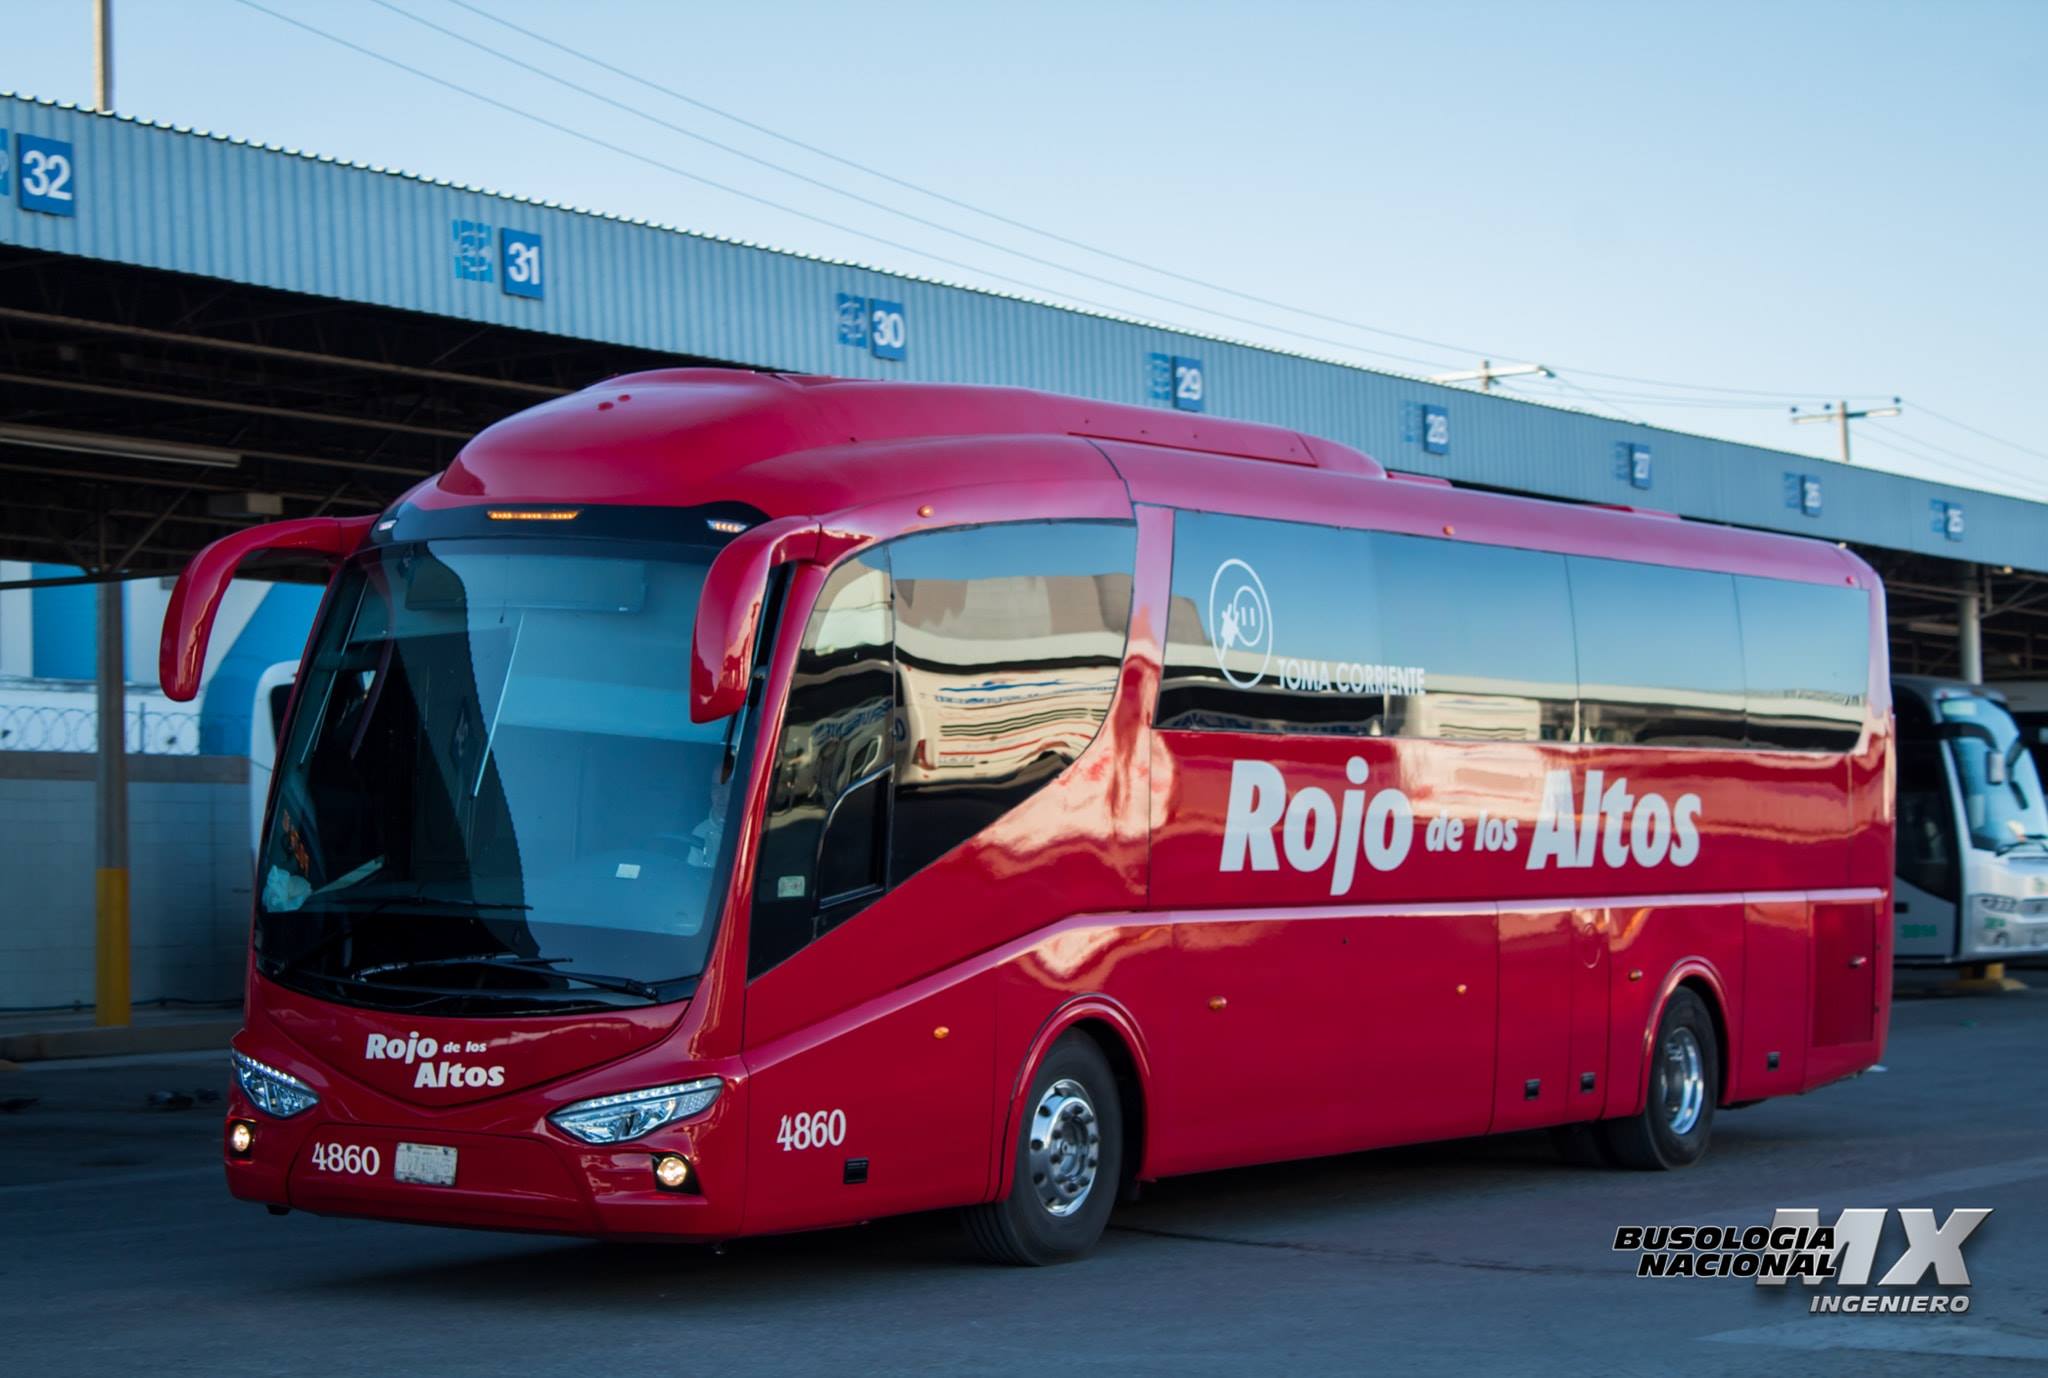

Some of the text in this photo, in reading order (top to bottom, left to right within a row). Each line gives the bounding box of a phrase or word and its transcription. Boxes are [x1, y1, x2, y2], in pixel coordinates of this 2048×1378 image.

[22, 149, 73, 201] 32
[508, 241, 541, 286] 31
[873, 309, 905, 349] 30
[1175, 366, 1202, 401] 29
[1426, 413, 1448, 445] 28
[1277, 658, 1425, 696] TOMA CORRIENTE
[1219, 756, 1702, 896] Rojo de los Altos
[365, 1031, 487, 1064] Rojo de los
[413, 1062, 505, 1089] Altos
[776, 1108, 847, 1151] 4860
[311, 1142, 380, 1176] 4860
